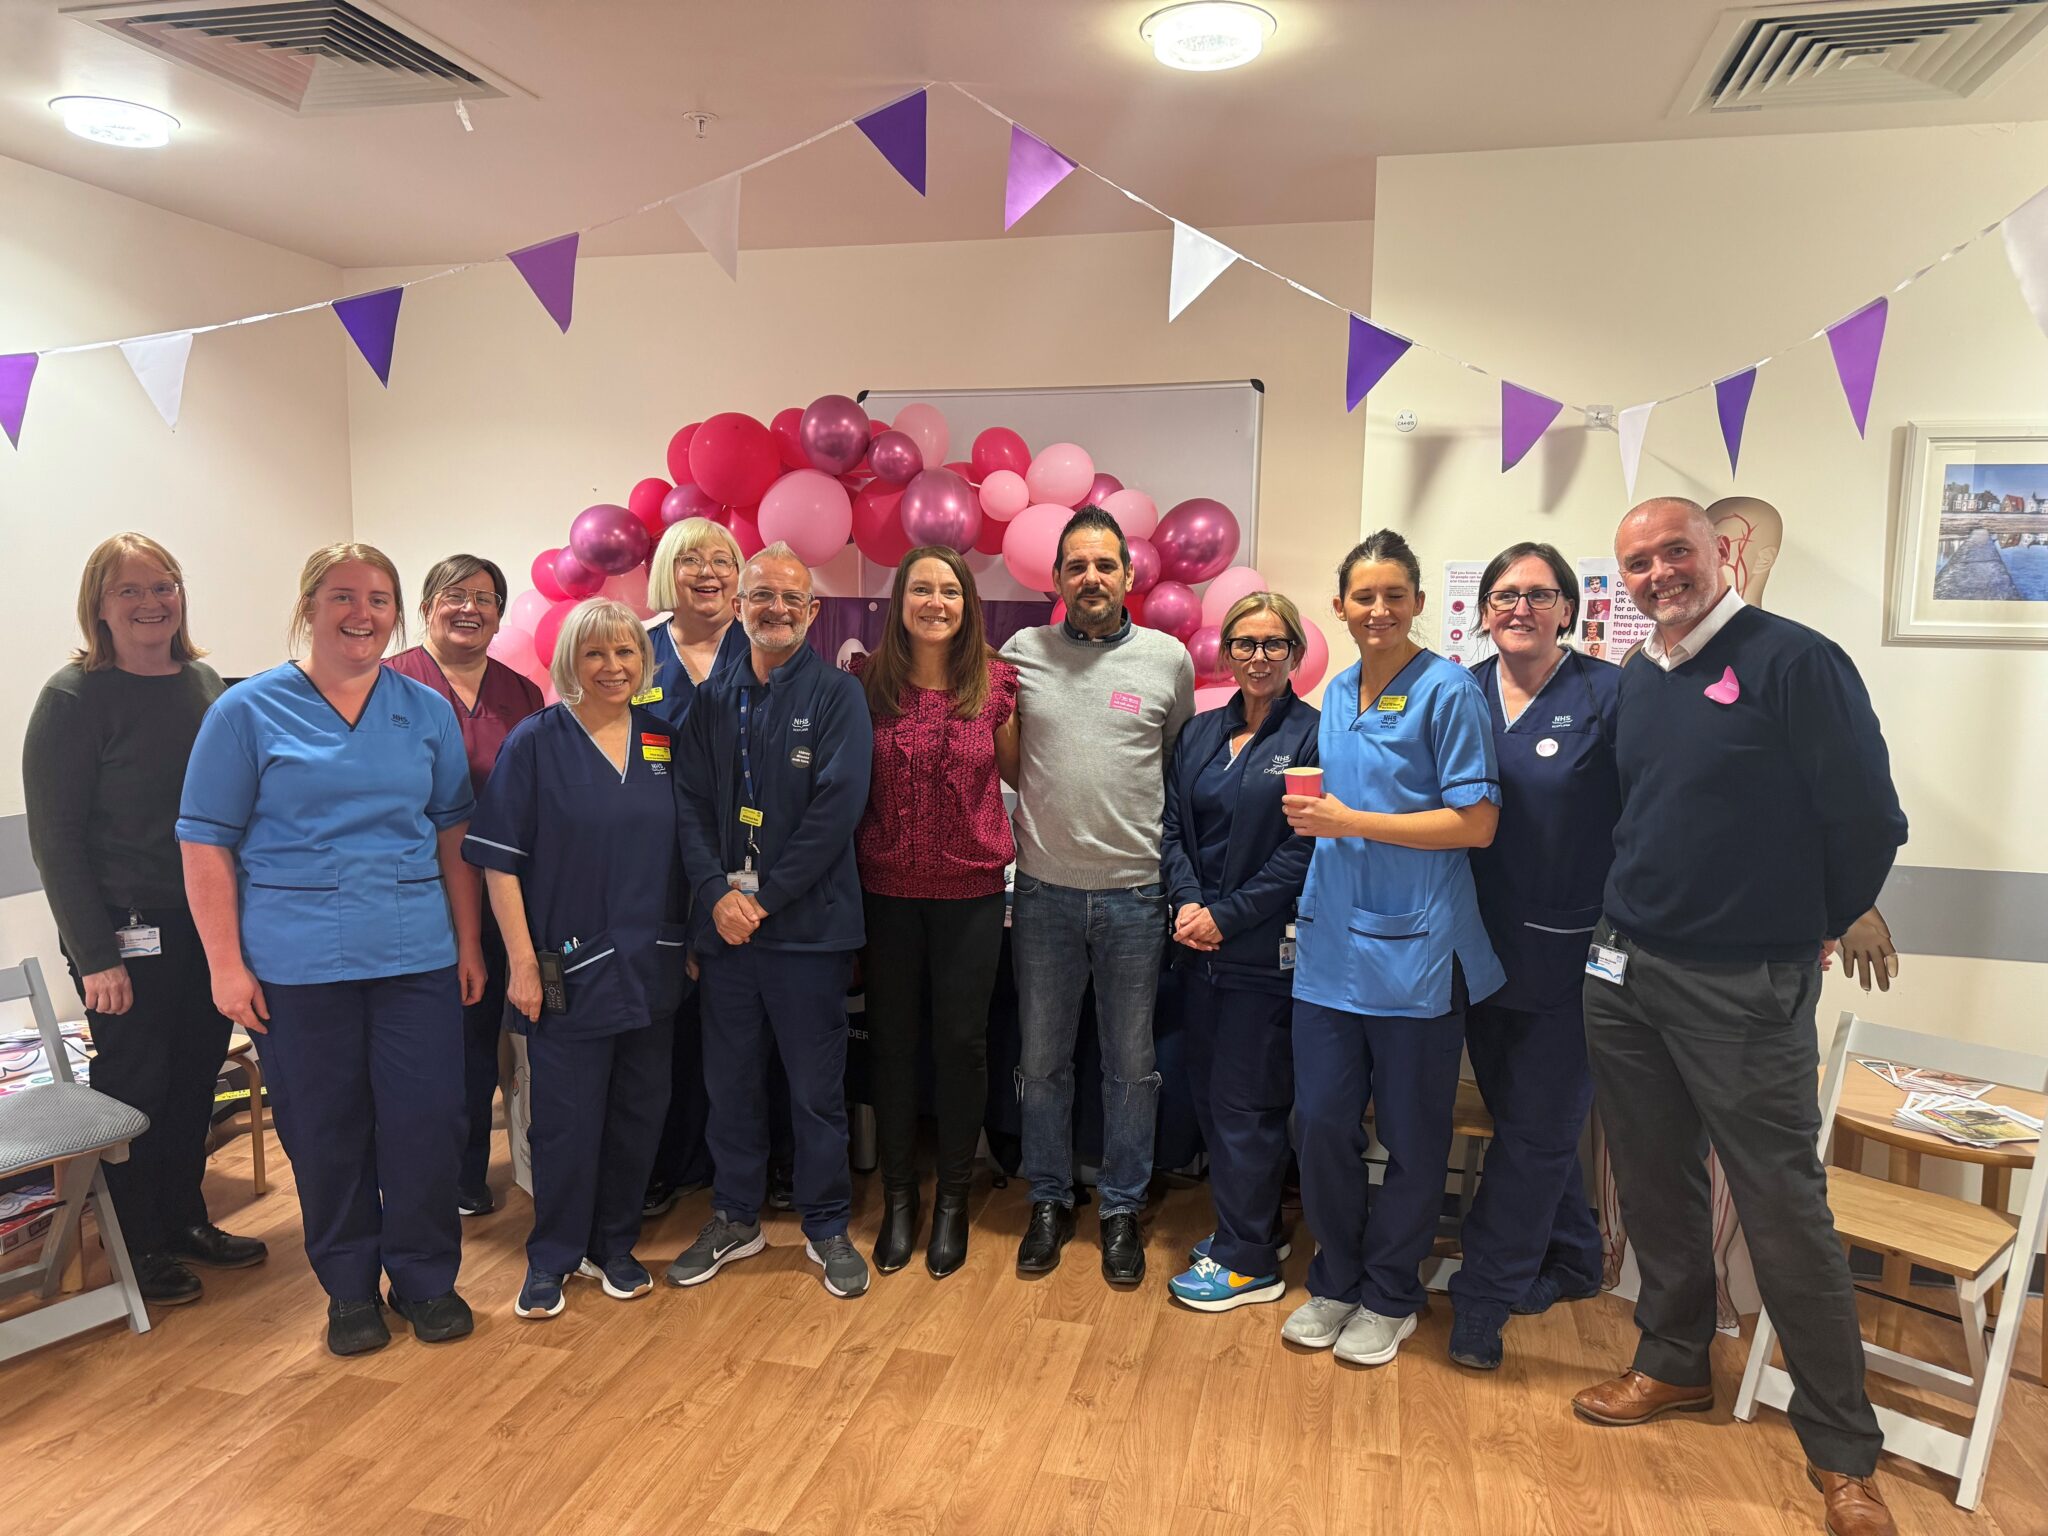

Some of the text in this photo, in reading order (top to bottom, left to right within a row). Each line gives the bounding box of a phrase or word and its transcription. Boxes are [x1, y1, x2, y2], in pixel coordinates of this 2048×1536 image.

[794, 717, 809, 725] NHS
[1383, 714, 1397, 722] NHS
[1274, 754, 1290, 762] NHS
